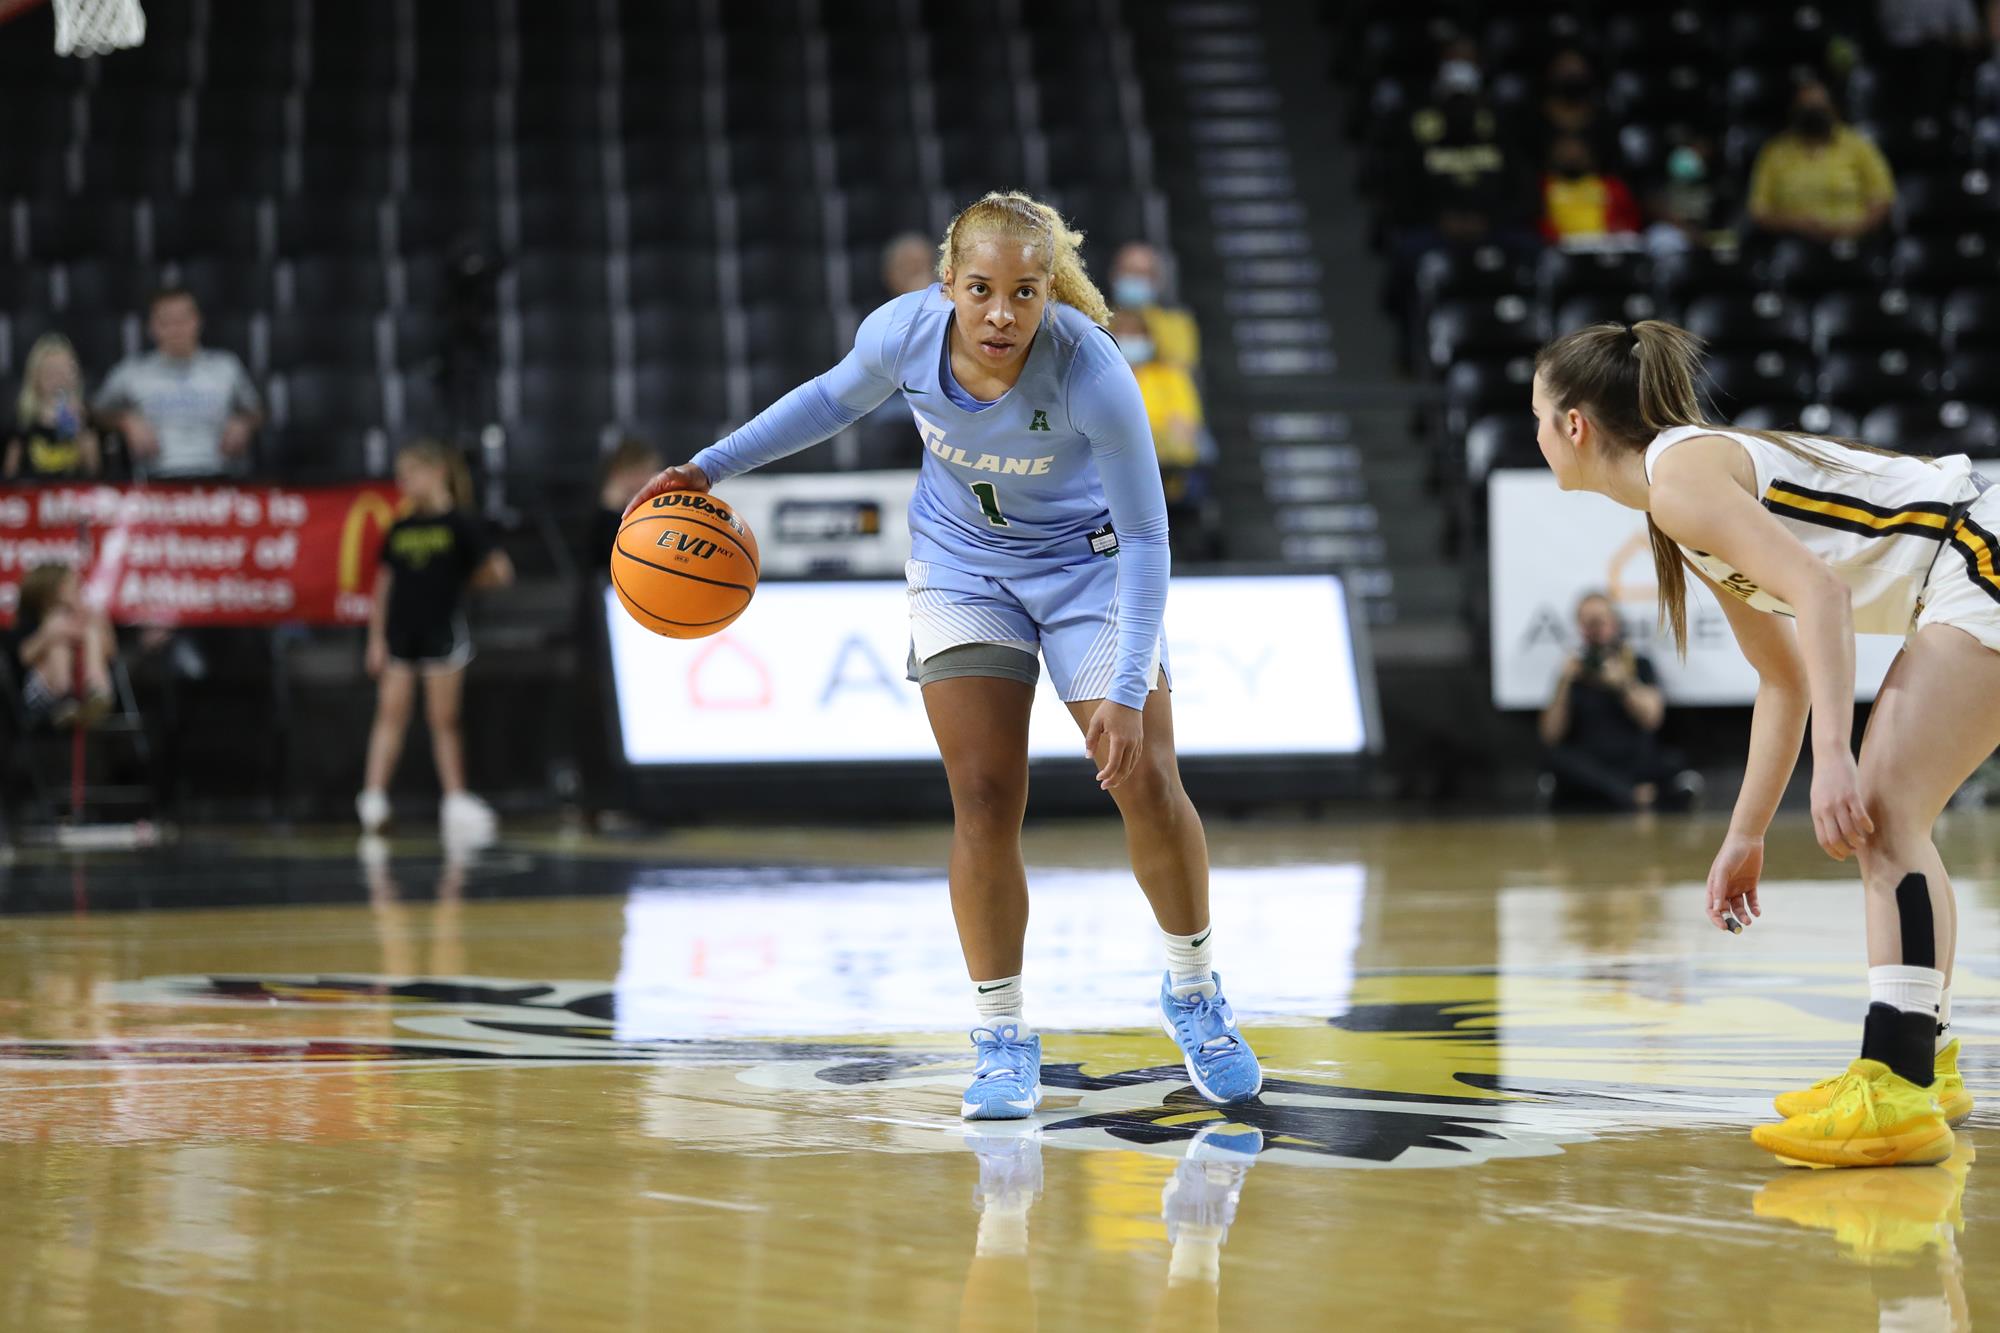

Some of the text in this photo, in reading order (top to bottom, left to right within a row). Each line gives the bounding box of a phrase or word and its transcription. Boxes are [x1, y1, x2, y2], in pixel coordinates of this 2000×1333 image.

[652, 494, 745, 537] Wilson
[968, 480, 1011, 528] 1
[126, 530, 246, 569] artner
[656, 528, 717, 560] EVO
